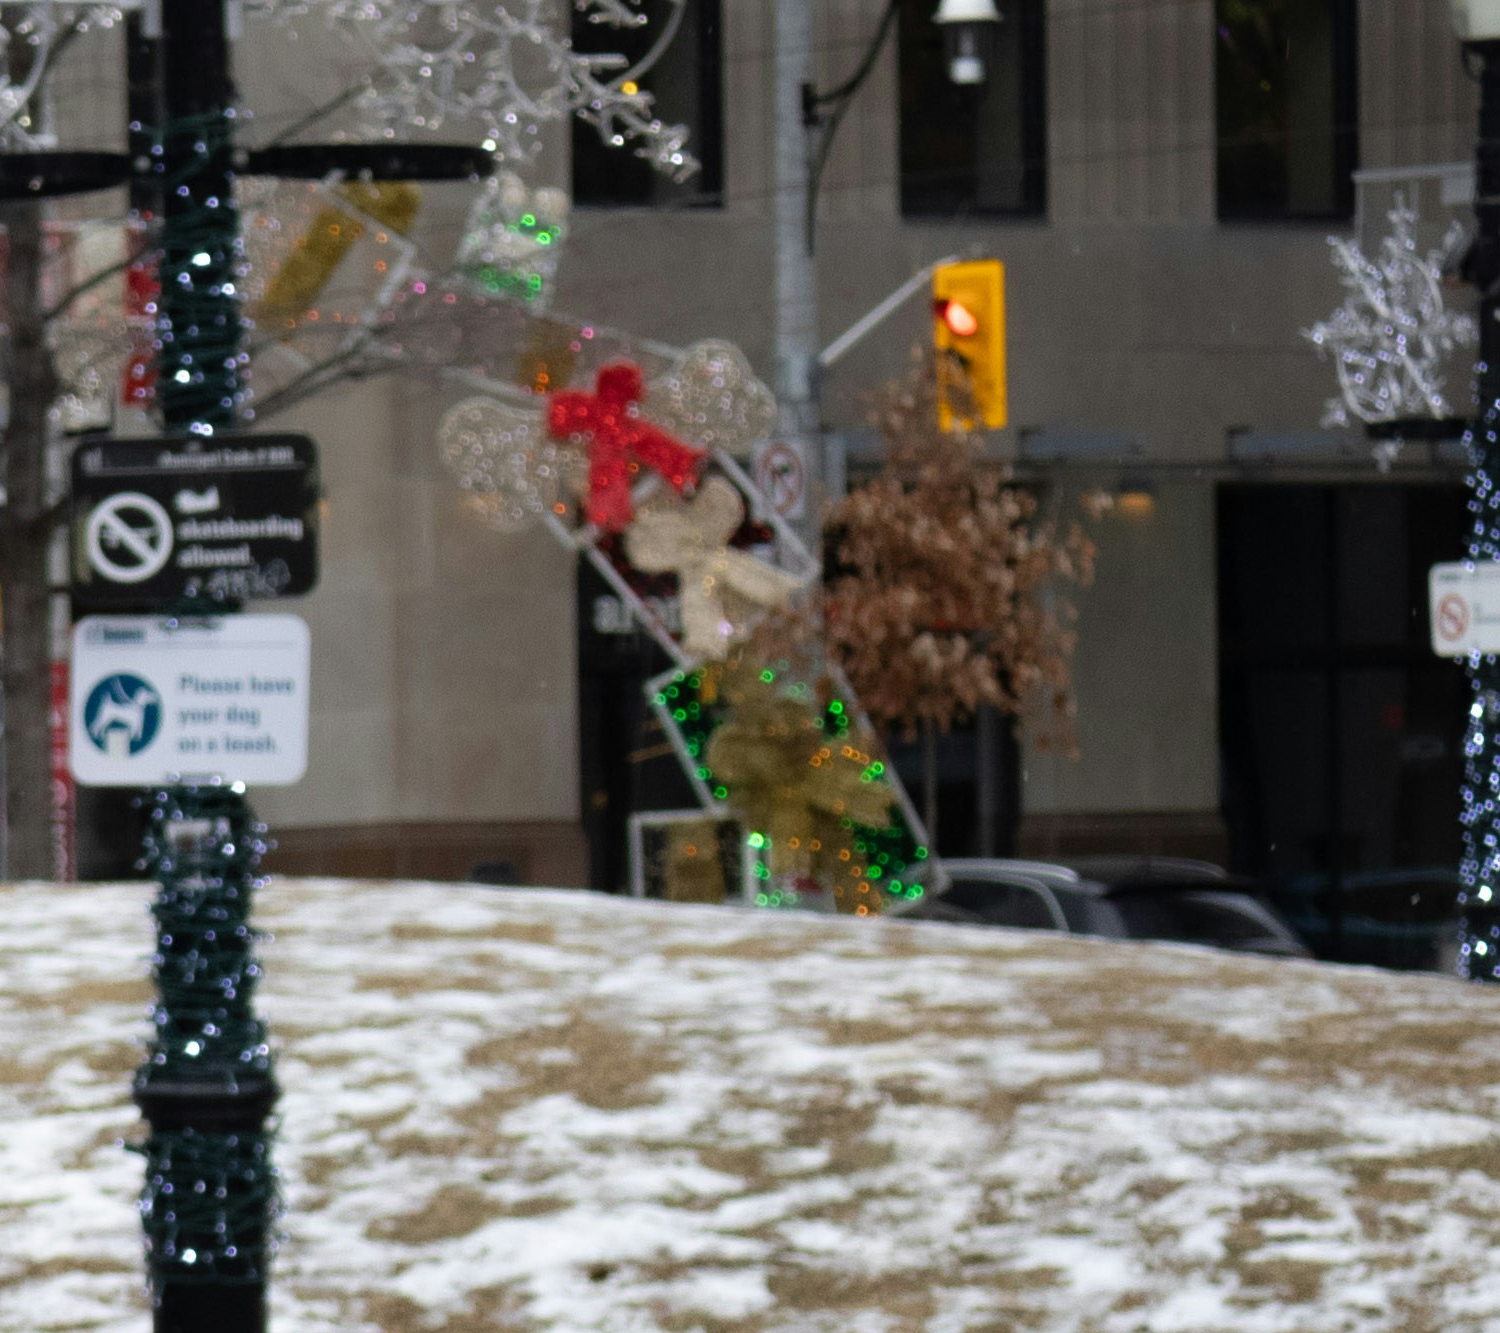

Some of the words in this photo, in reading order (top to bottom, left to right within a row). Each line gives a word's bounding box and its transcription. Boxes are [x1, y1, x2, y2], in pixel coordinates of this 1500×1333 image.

[177, 516, 305, 542] skateboarding
[179, 674, 242, 694] Please
[251, 673, 296, 694] have
[178, 707, 221, 728] your
[225, 704, 262, 728] dog
[179, 738, 201, 753] on
[205, 738, 218, 753] a
